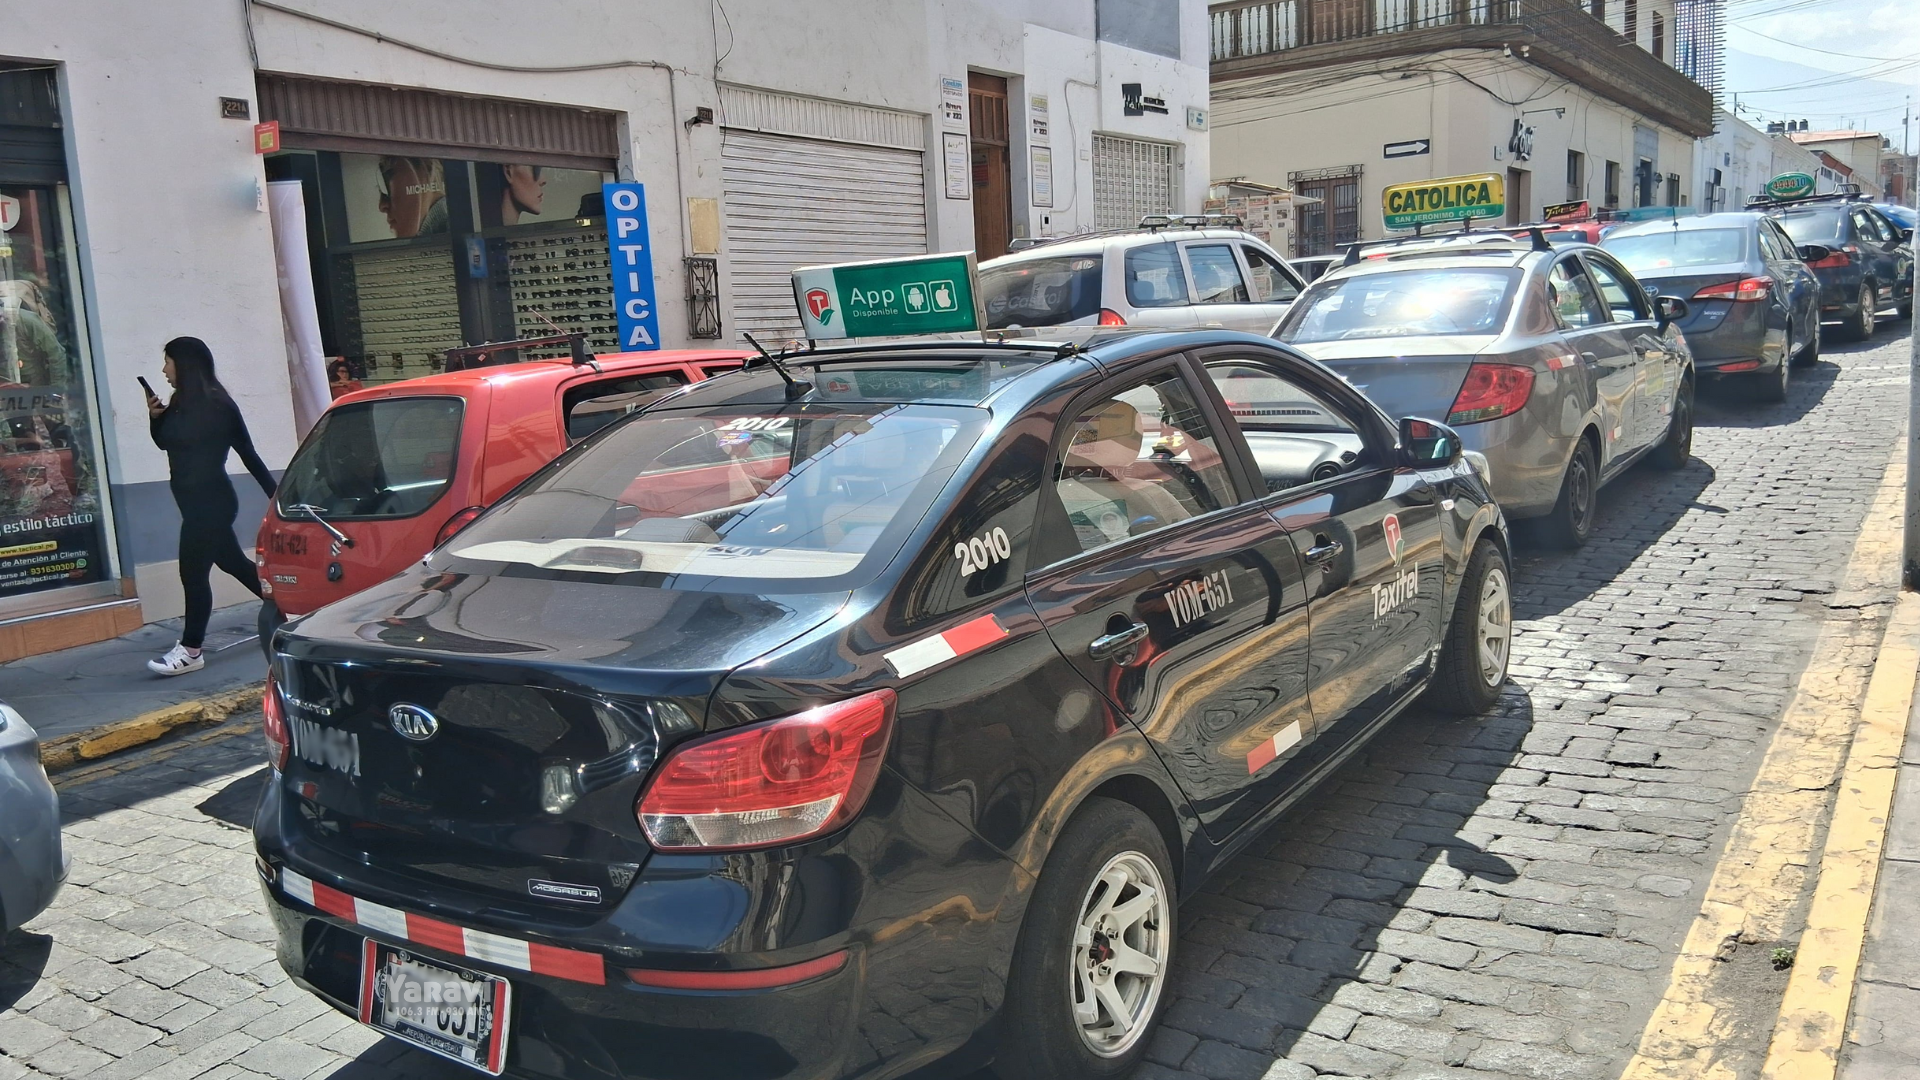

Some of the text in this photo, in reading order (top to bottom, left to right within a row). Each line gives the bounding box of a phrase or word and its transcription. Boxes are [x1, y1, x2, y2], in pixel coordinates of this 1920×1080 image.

[226, 101, 247, 112] 221A
[405, 182, 441, 195] MICHAEL
[1388, 182, 1491, 213] CATOLICA
[1395, 215, 1411, 223] SAN
[1412, 211, 1454, 221] JERONIMO
[611, 190, 655, 346] OPTICA
[850, 287, 895, 308] App
[853, 307, 899, 318] Disponible
[717, 416, 790, 431] 2010
[3, 512, 93, 534] estilo táctico
[14, 555, 49, 566] Atención
[954, 526, 1011, 577] 2010
[1371, 561, 1418, 620] Taxitel
[392, 710, 429, 736] KIA
[532, 883, 598, 898] MOTORSUR
